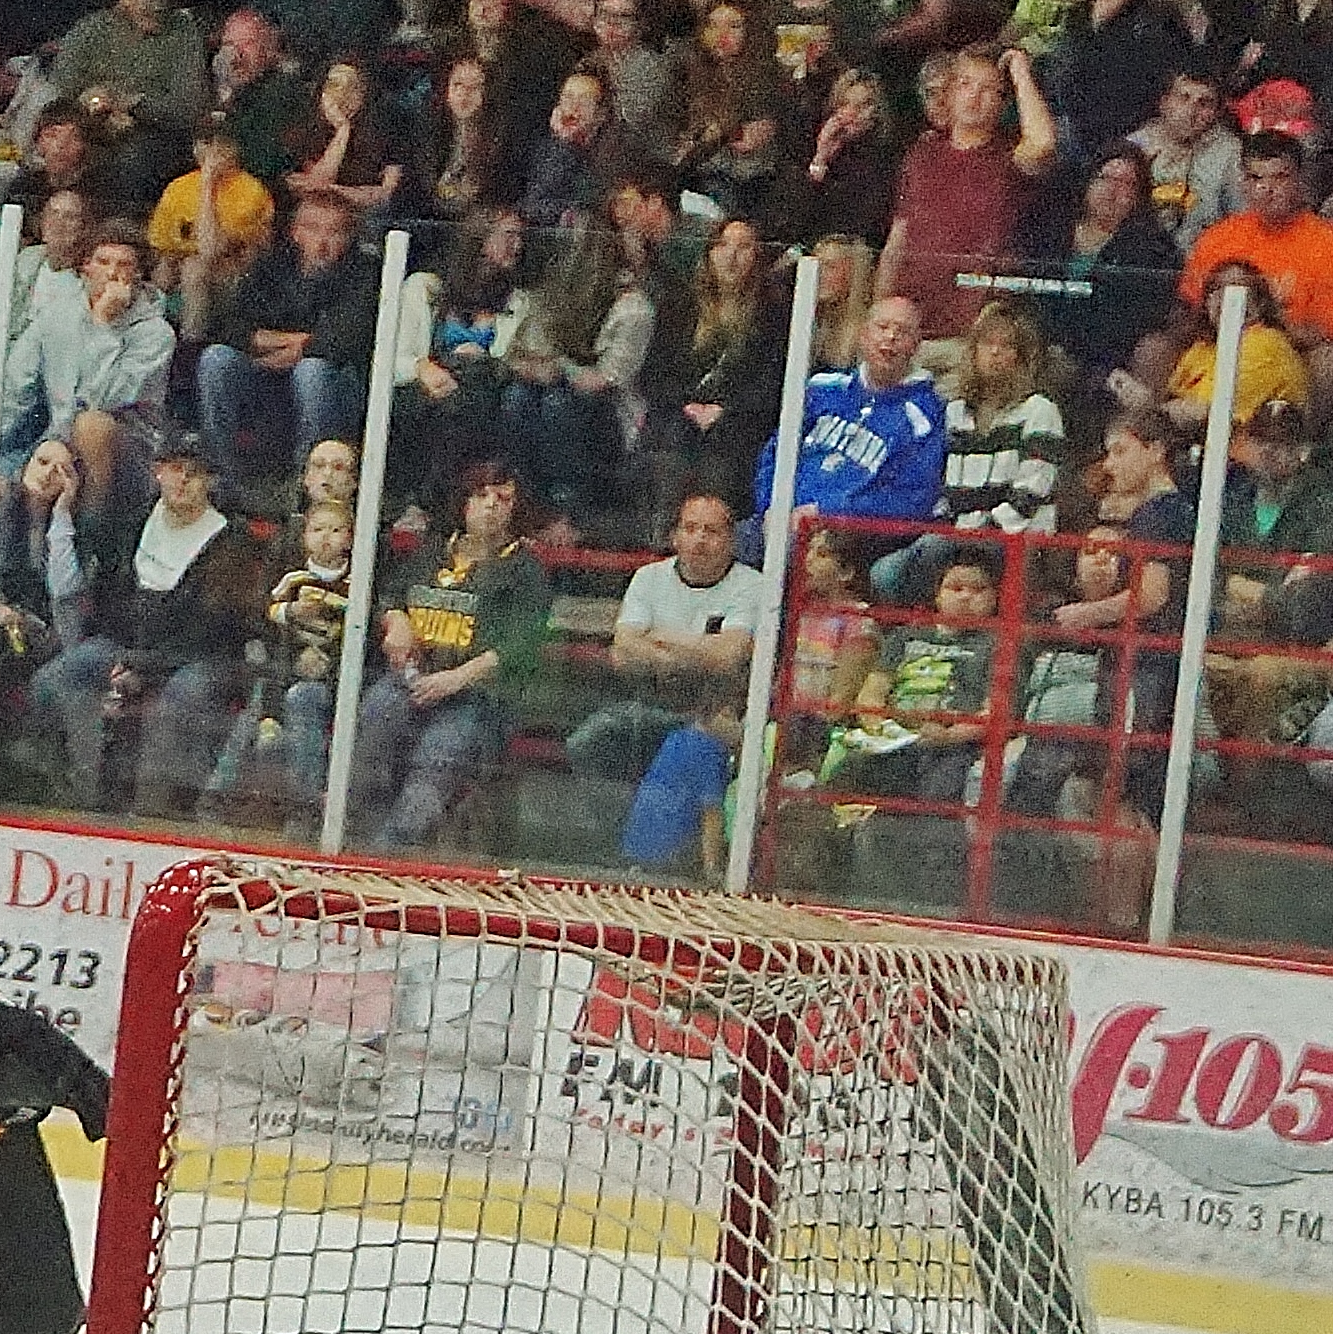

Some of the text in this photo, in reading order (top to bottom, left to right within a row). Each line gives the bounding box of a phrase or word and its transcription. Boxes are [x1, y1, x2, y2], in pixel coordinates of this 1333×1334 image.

[4, 847, 151, 921] Dail
[1081, 1179, 1324, 1242] KYBA 105.3 FM
